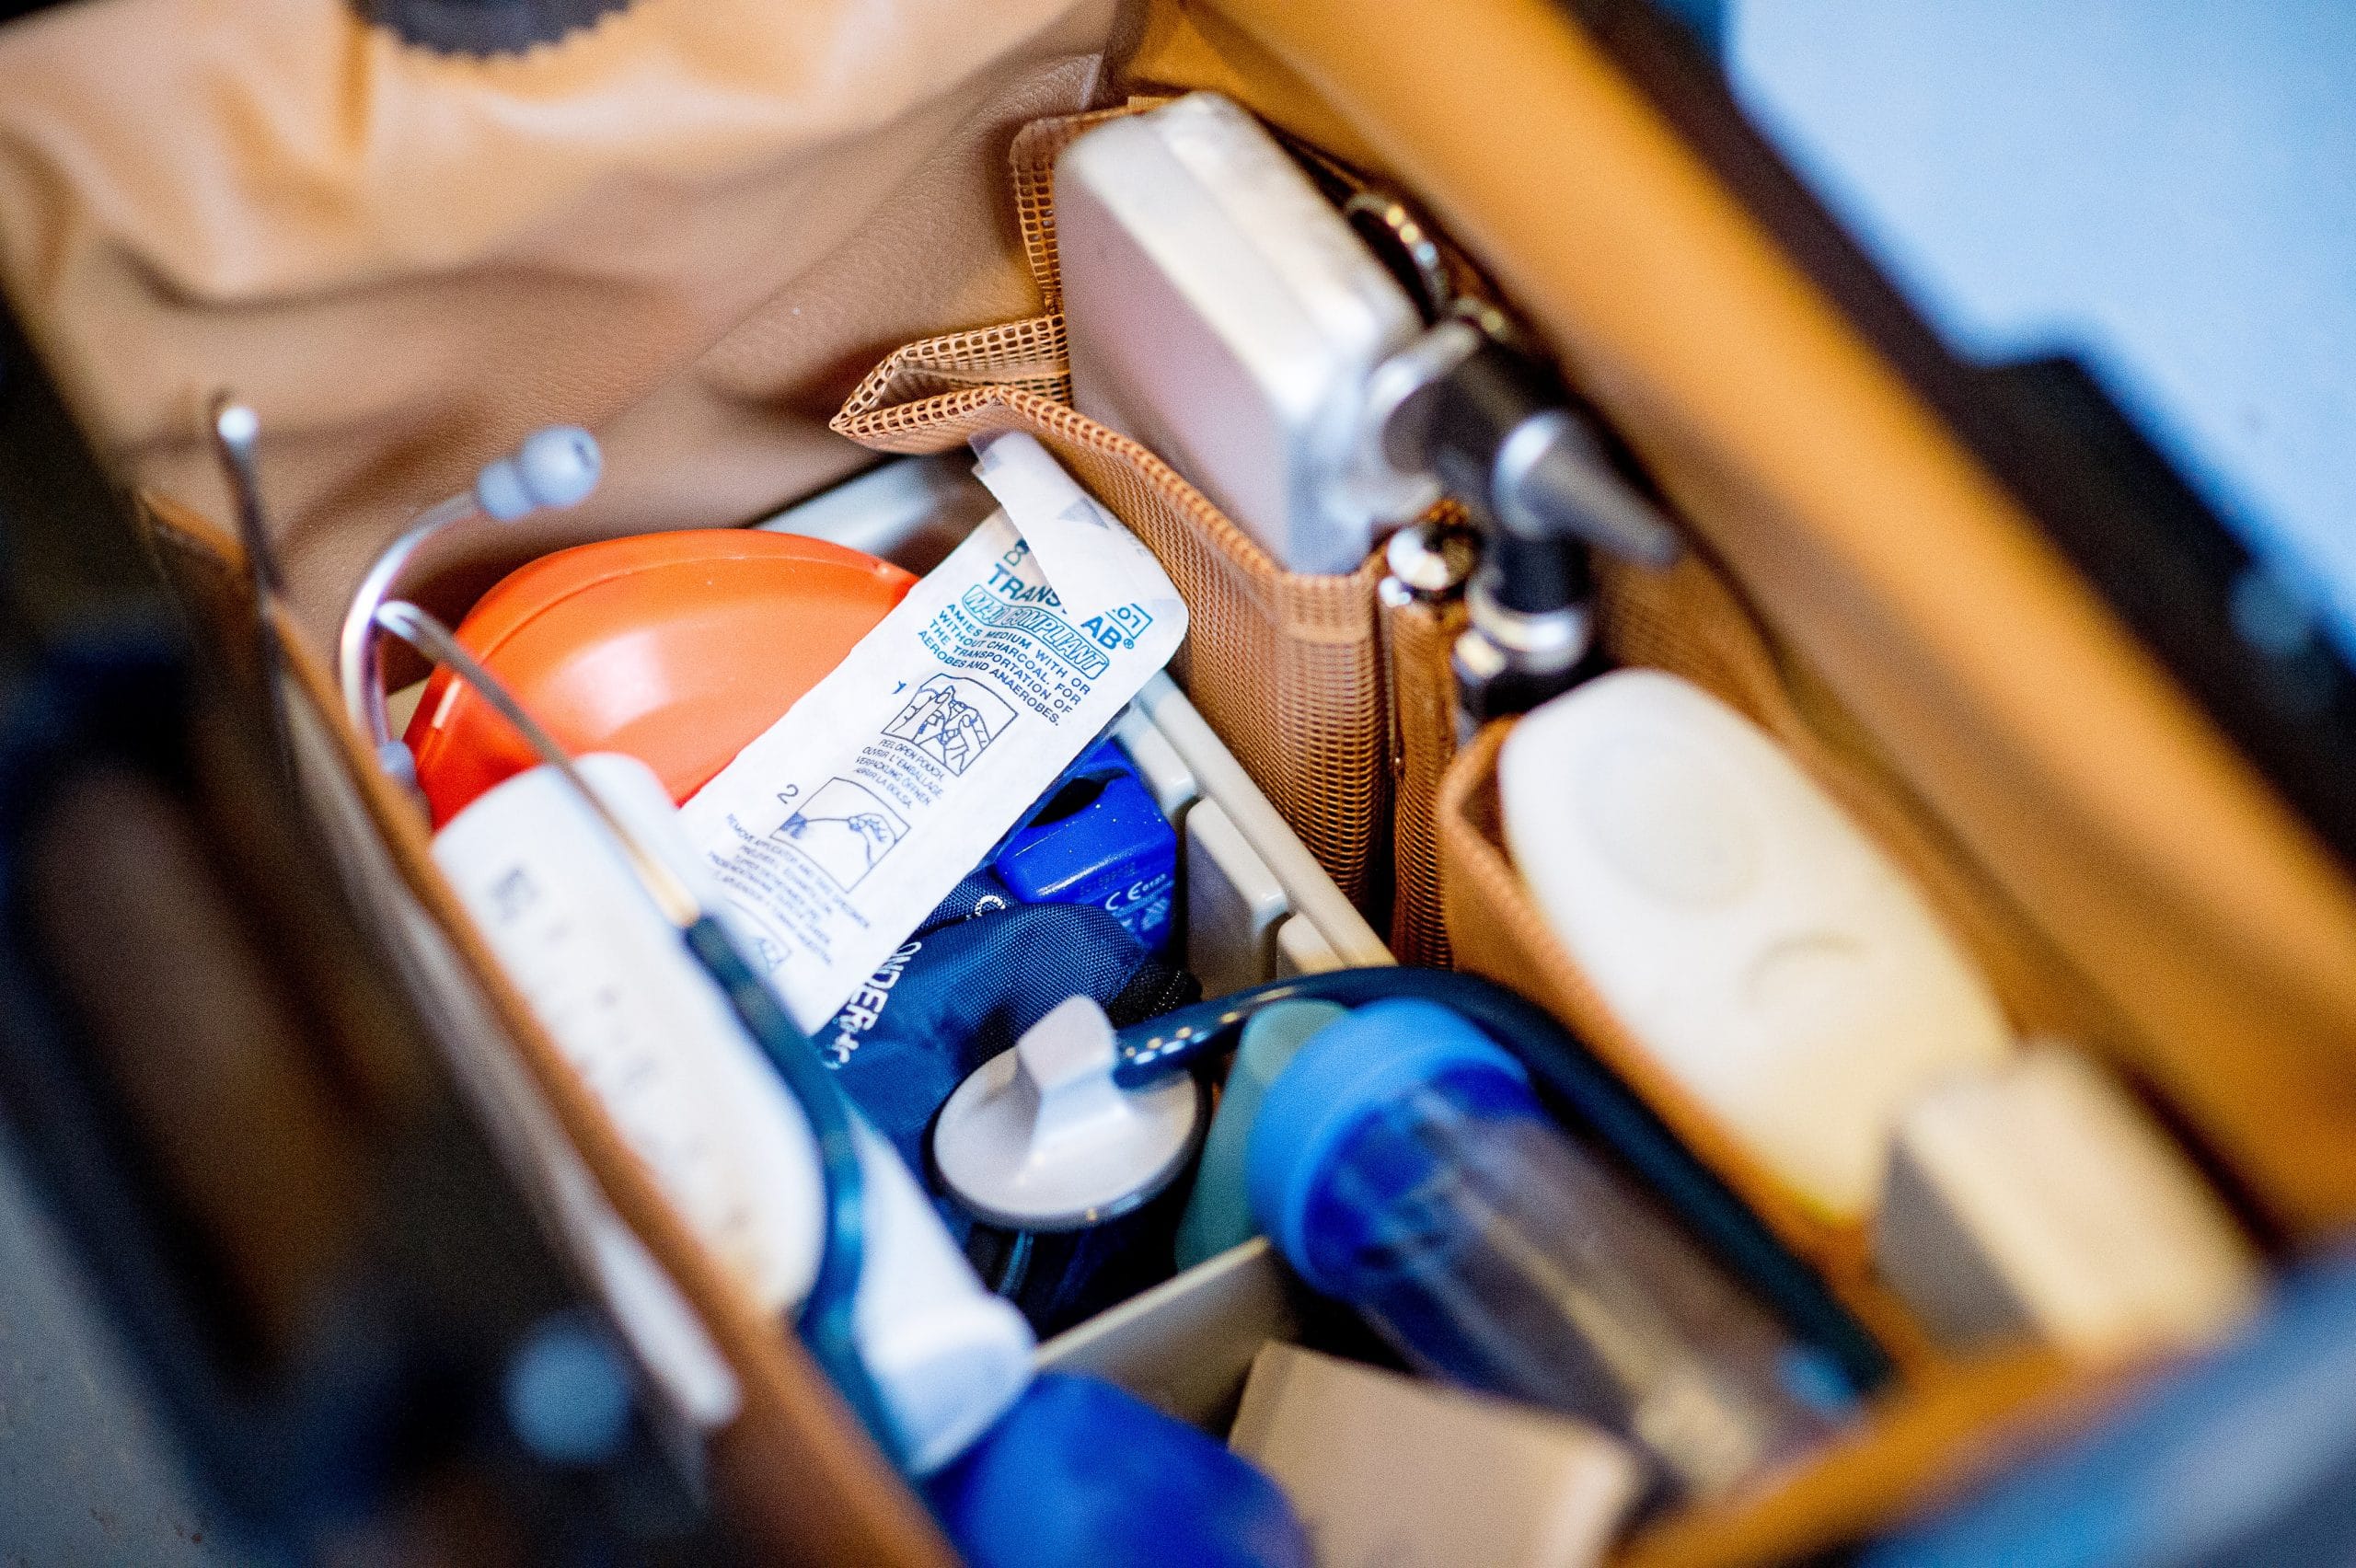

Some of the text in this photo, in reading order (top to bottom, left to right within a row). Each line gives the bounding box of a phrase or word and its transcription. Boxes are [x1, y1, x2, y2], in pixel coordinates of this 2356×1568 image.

[947, 605, 1090, 695] AMIES MEDIUM WITH OR
[1000, 607, 1106, 677] COMPLIANT
[1112, 607, 1140, 628] LO
[918, 631, 1058, 725] AEROBES AND ANAEROBES.
[930, 619, 1072, 712] THE TRANSPORTATION OF
[940, 611, 985, 647] WITHOUT
[1055, 683, 1080, 705] FOR
[878, 739, 895, 748] PEEL
[895, 744, 917, 758] OPEN
[777, 784, 799, 805] 2
